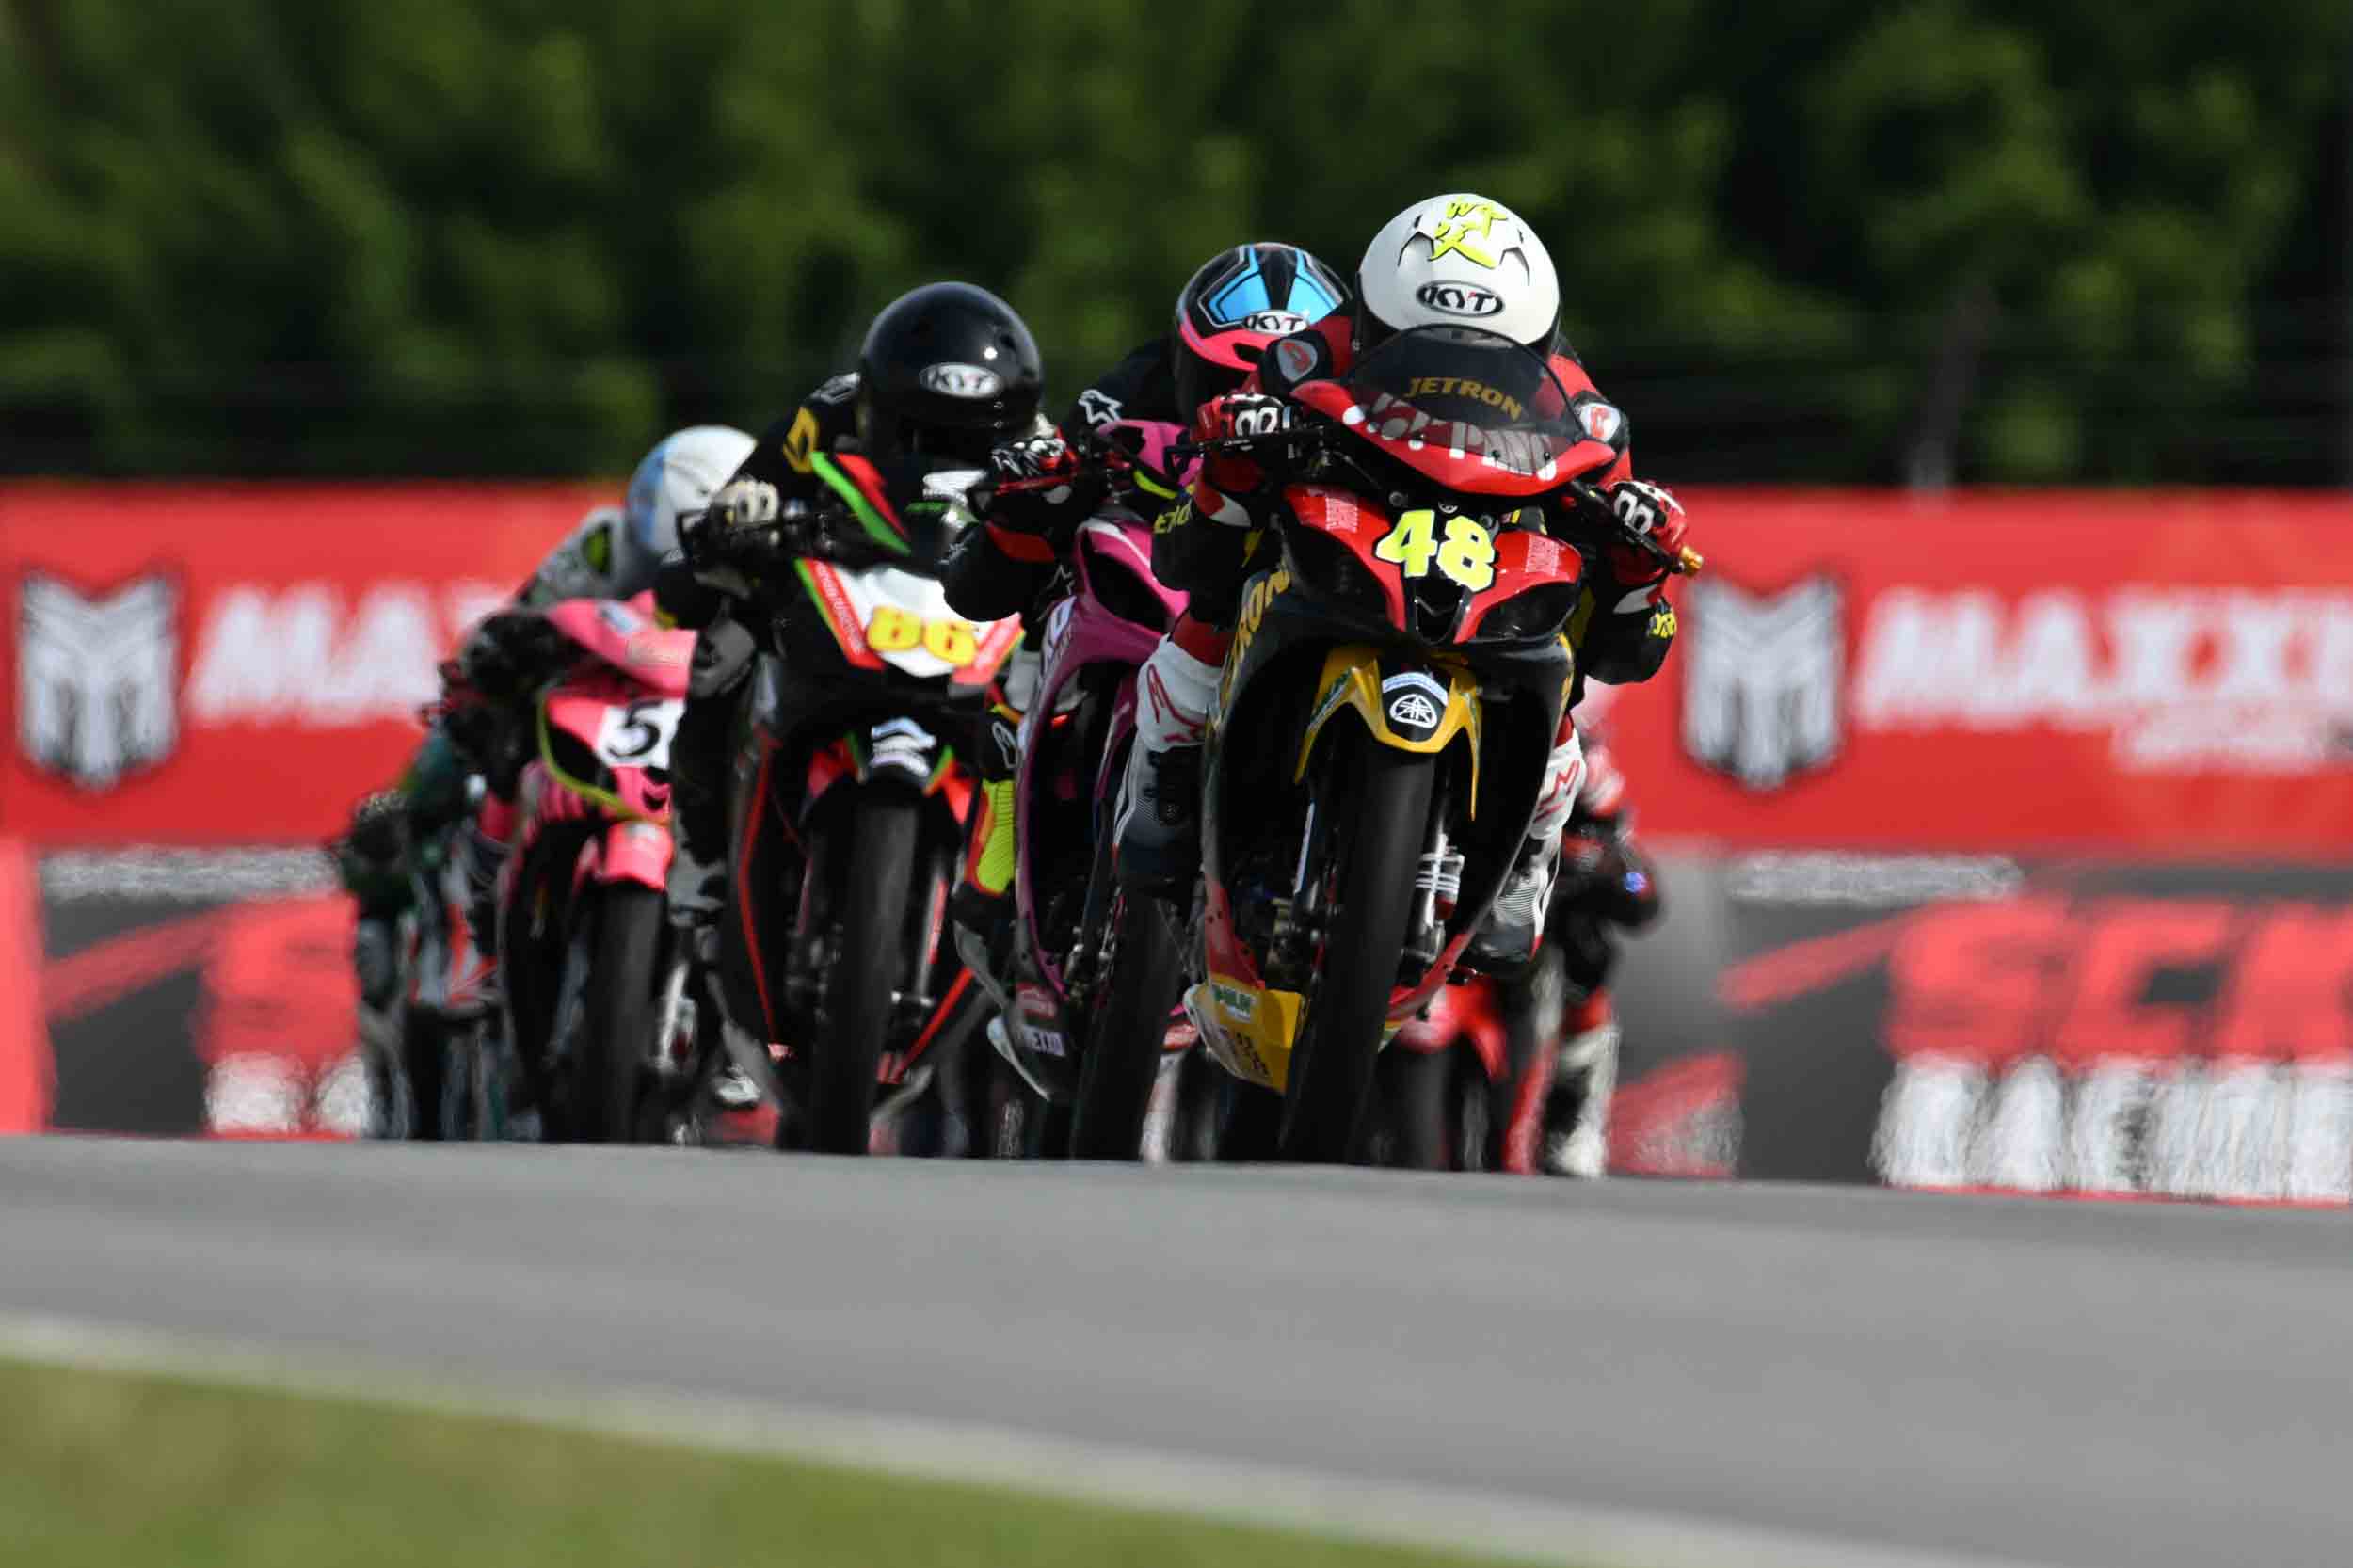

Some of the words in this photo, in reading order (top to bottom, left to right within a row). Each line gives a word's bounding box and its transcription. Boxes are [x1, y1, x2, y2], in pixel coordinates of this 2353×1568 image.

[1417, 284, 1497, 312] KYT
[1243, 313, 1305, 332] KYT
[1405, 376, 1522, 422] JETRON
[1375, 509, 1497, 593] 48
